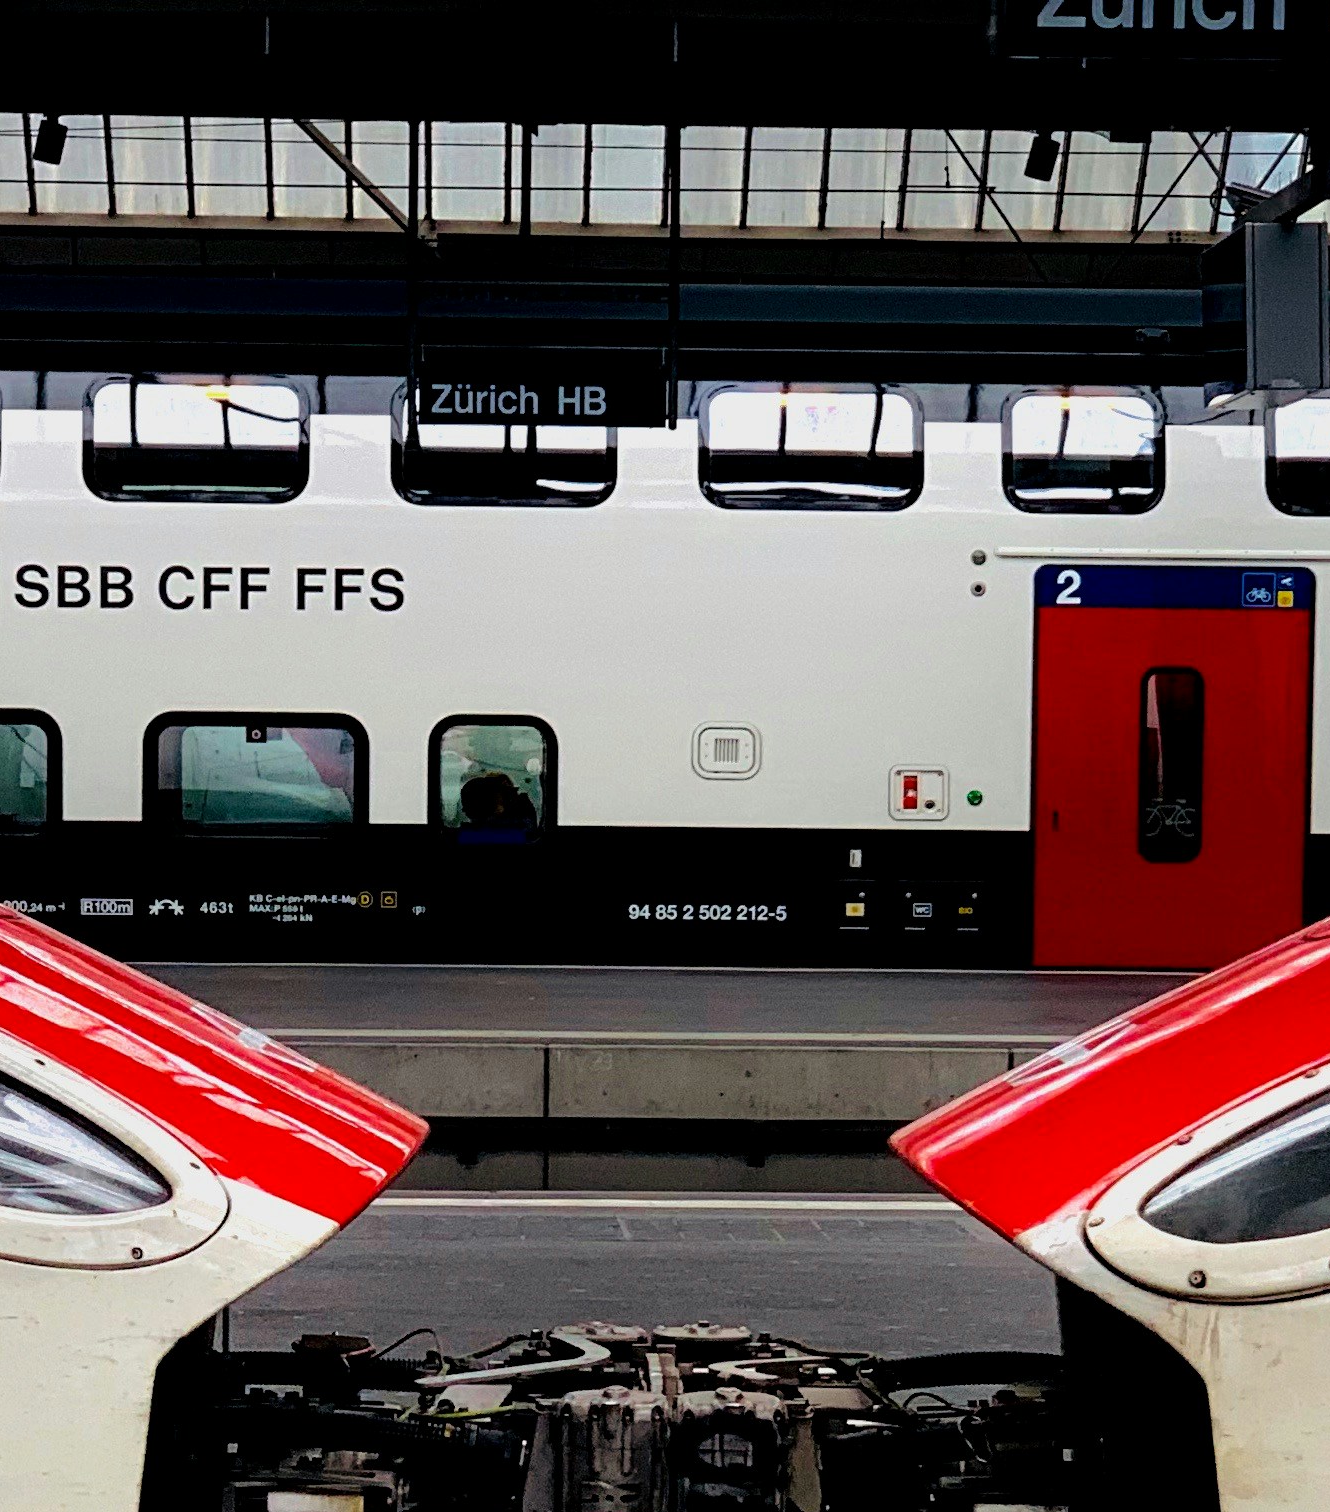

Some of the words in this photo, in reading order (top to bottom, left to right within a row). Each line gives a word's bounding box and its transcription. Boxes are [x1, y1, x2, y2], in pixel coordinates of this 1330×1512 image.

[431, 383, 539, 415] Zürich
[558, 385, 607, 416] HB
[14, 564, 134, 609] SBB
[158, 565, 271, 610] CFF
[296, 567, 406, 612] FFS
[1055, 569, 1082, 605] 2
[83, 901, 131, 914] R100m
[199, 901, 234, 914] 463t
[628, 904, 651, 920] 94
[655, 904, 678, 920] 85
[682, 904, 695, 920] 2
[699, 904, 732, 921] 502
[736, 904, 788, 921] 212-5
